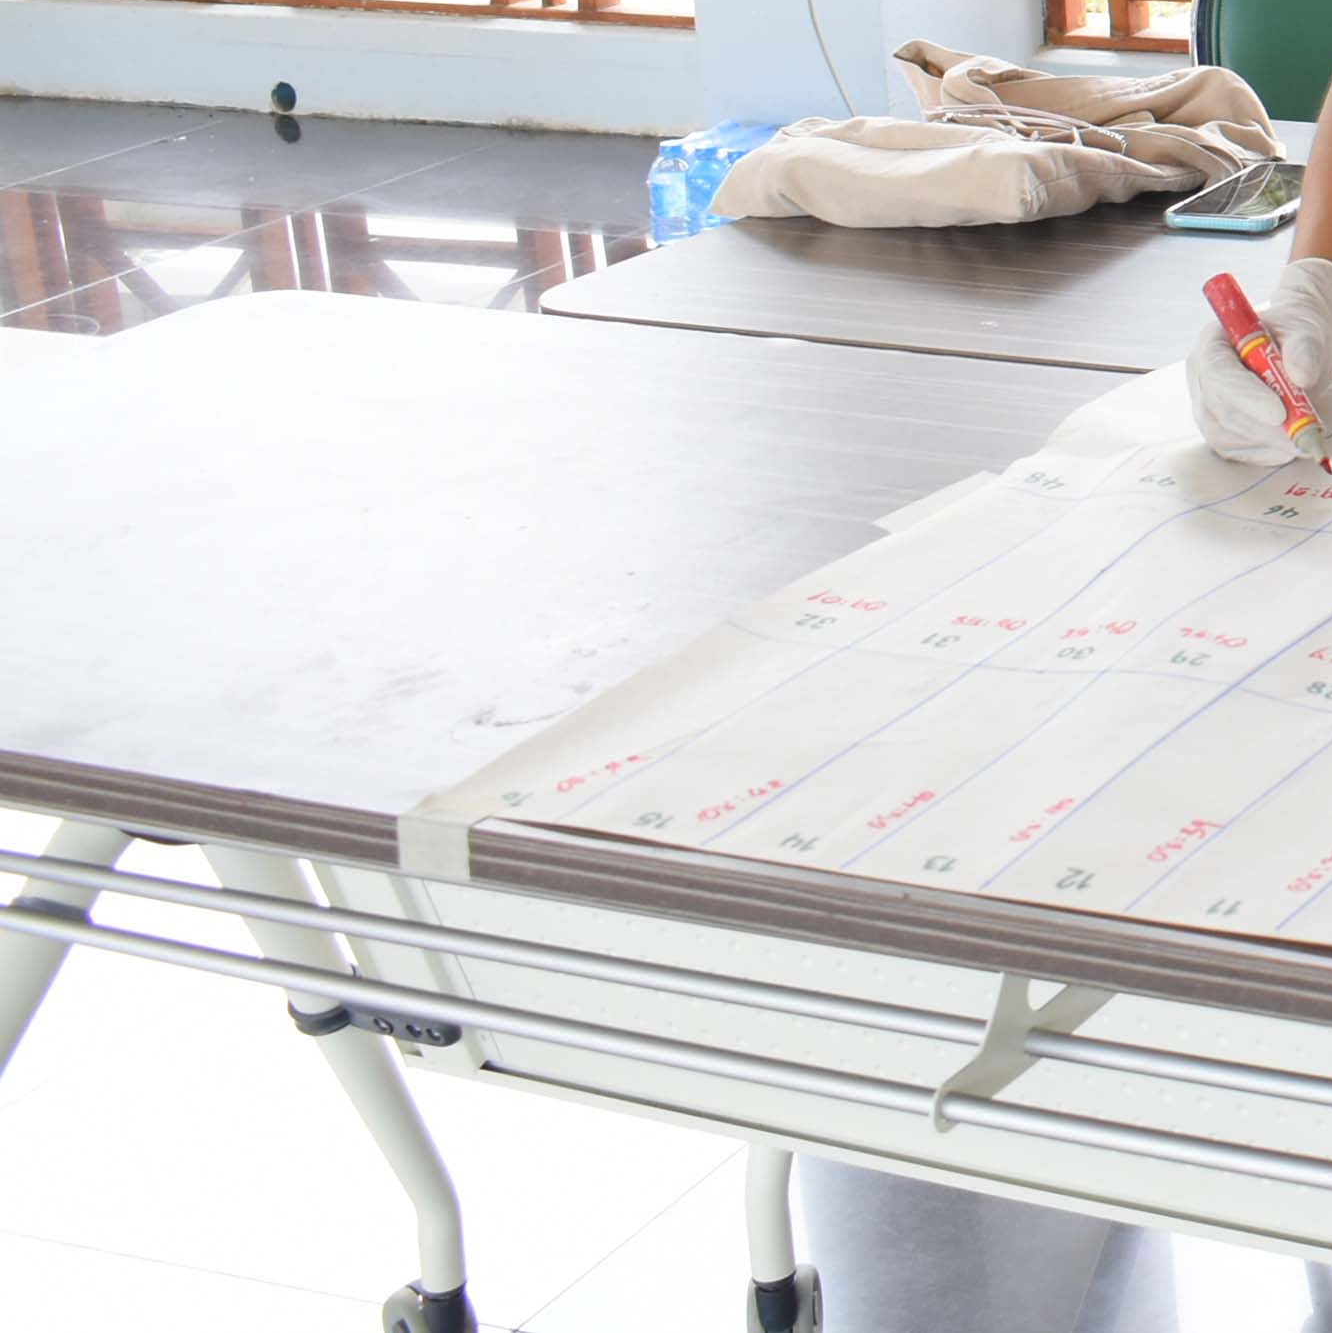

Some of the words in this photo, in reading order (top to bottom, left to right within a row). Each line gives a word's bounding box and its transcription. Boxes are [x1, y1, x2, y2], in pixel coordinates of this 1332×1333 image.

[1263, 504, 1300, 520] 46
[794, 612, 838, 630] 32
[919, 632, 961, 649] 31
[1169, 650, 1212, 668] 29
[631, 811, 674, 830] 15
[779, 832, 820, 853] 14
[922, 855, 957, 874] 13
[1055, 867, 1096, 891] 12
[1205, 898, 1241, 917] 11
